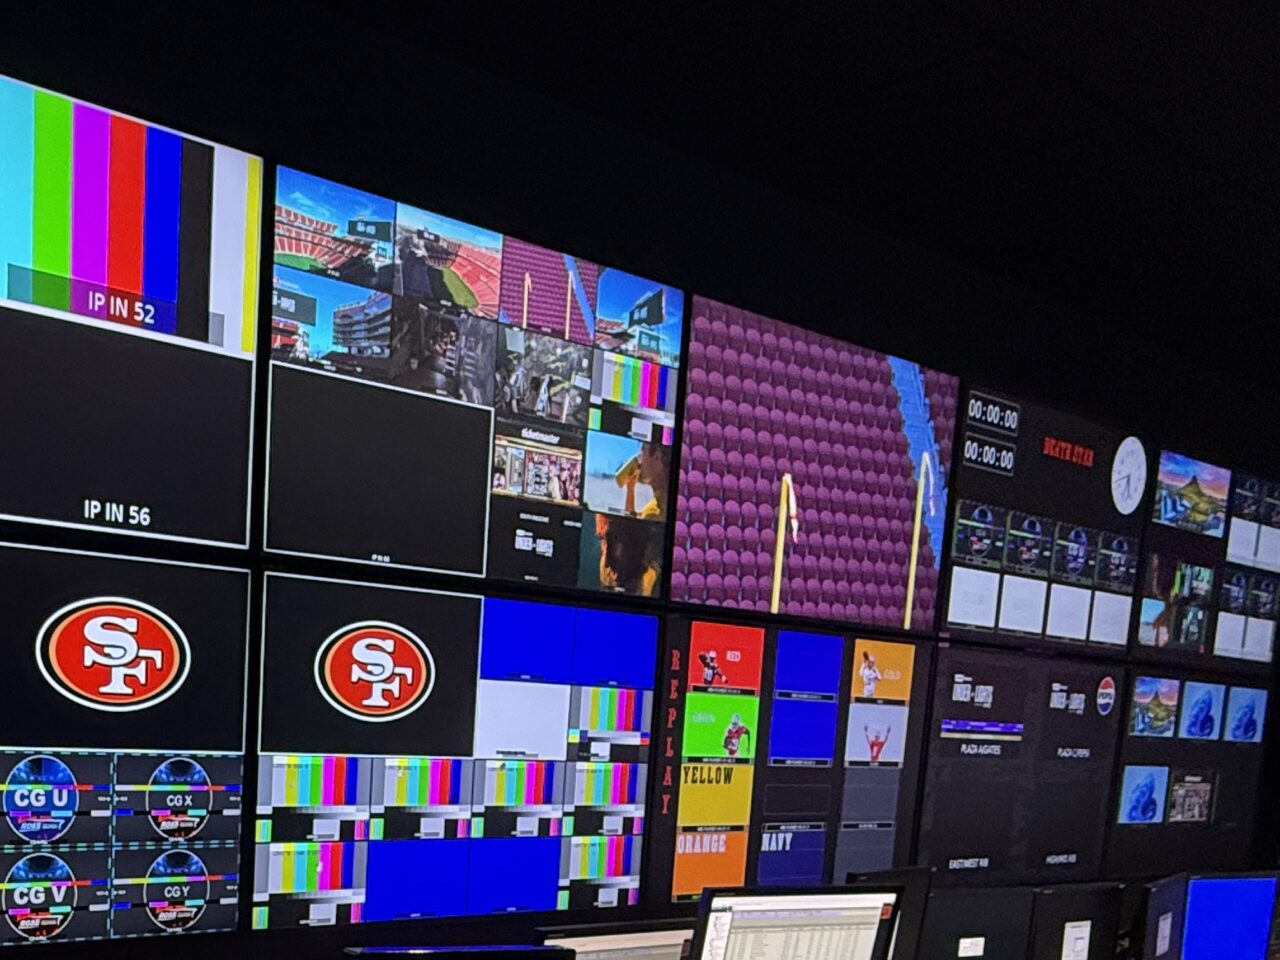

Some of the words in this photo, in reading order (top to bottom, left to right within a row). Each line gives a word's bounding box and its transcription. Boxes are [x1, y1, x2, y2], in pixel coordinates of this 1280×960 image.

[88, 290, 105, 311] IP
[111, 296, 128, 318] IN
[134, 302, 155, 324] 52
[968, 399, 1018, 429] 00:00:00
[964, 440, 1013, 470] 00:00:00
[83, 499, 102, 520] IP
[105, 502, 124, 524] IN
[128, 505, 151, 527] 56
[661, 650, 680, 815] REPLAY
[683, 765, 734, 785] YELLOW
[14, 789, 46, 807] CG
[53, 788, 68, 807] U
[167, 795, 183, 807] CG
[184, 795, 193, 807] X
[677, 833, 727, 854] ORANGE
[761, 833, 793, 851] NAVY
[14, 887, 46, 905] CG
[51, 886, 67, 903] V
[164, 886, 181, 898] CG
[182, 886, 190, 897] Y
